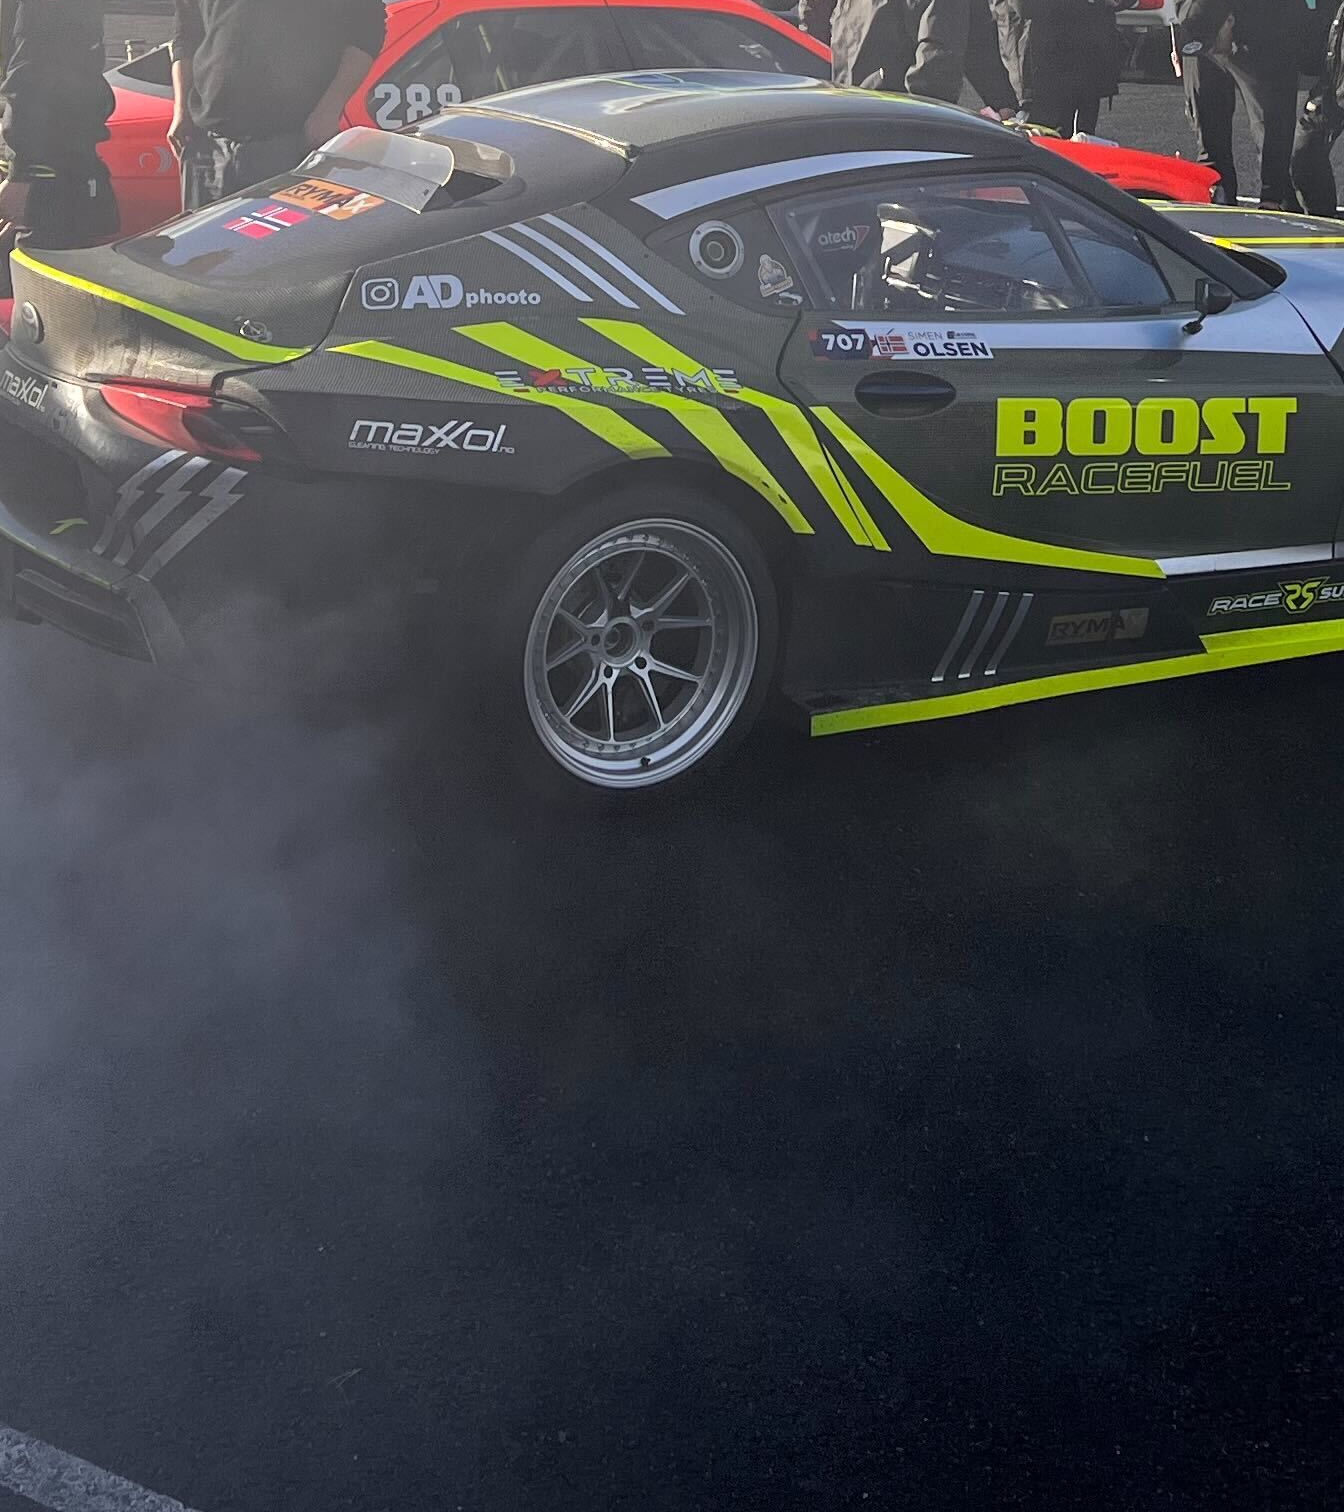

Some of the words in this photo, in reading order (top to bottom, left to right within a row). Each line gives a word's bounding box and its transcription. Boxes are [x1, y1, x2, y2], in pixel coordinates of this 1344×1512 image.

[401, 274, 464, 309] AD
[465, 289, 542, 308] phooto
[822, 334, 865, 351] 707
[907, 331, 943, 341] SIMEN
[912, 342, 989, 357] OLSEN
[494, 367, 742, 388] EXTREME
[995, 396, 1298, 457] BOOST
[992, 460, 1292, 497] RACEFUEL
[1211, 593, 1283, 613] RACE
